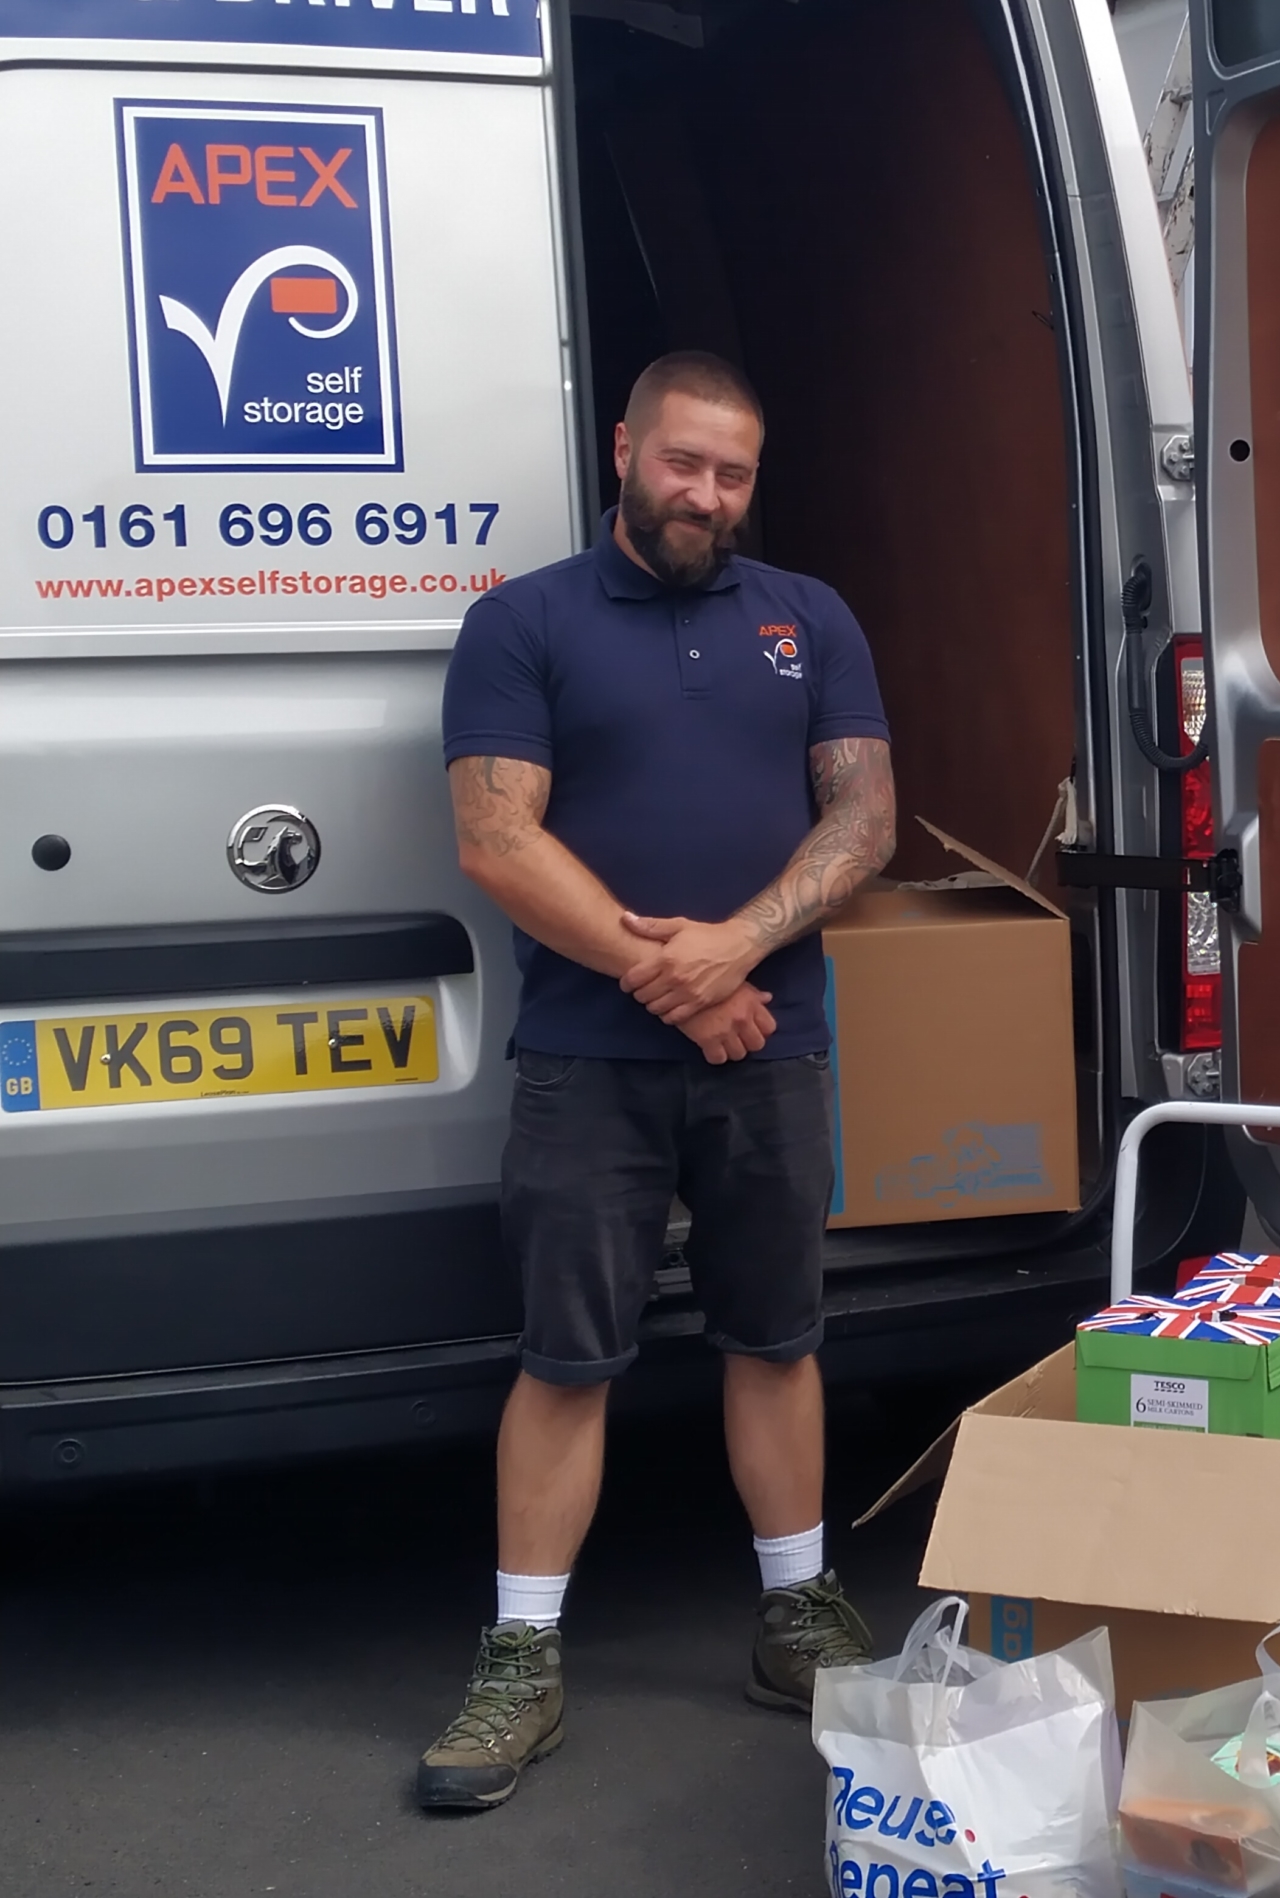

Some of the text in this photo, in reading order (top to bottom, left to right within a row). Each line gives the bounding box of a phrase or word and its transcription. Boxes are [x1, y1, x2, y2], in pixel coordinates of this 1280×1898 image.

[151, 143, 358, 208] APEX
[306, 366, 361, 393] self
[243, 397, 363, 429] storage
[37, 502, 500, 549] 0161 696 6917
[36, 568, 507, 600] www.apexselfstorage.co.uk
[759, 625, 796, 637] APEX
[53, 1005, 415, 1091] VK69 TEV
[6, 1076, 33, 1096] GB
[1154, 1380, 1185, 1390] TESCO
[1136, 1397, 1146, 1413] 6
